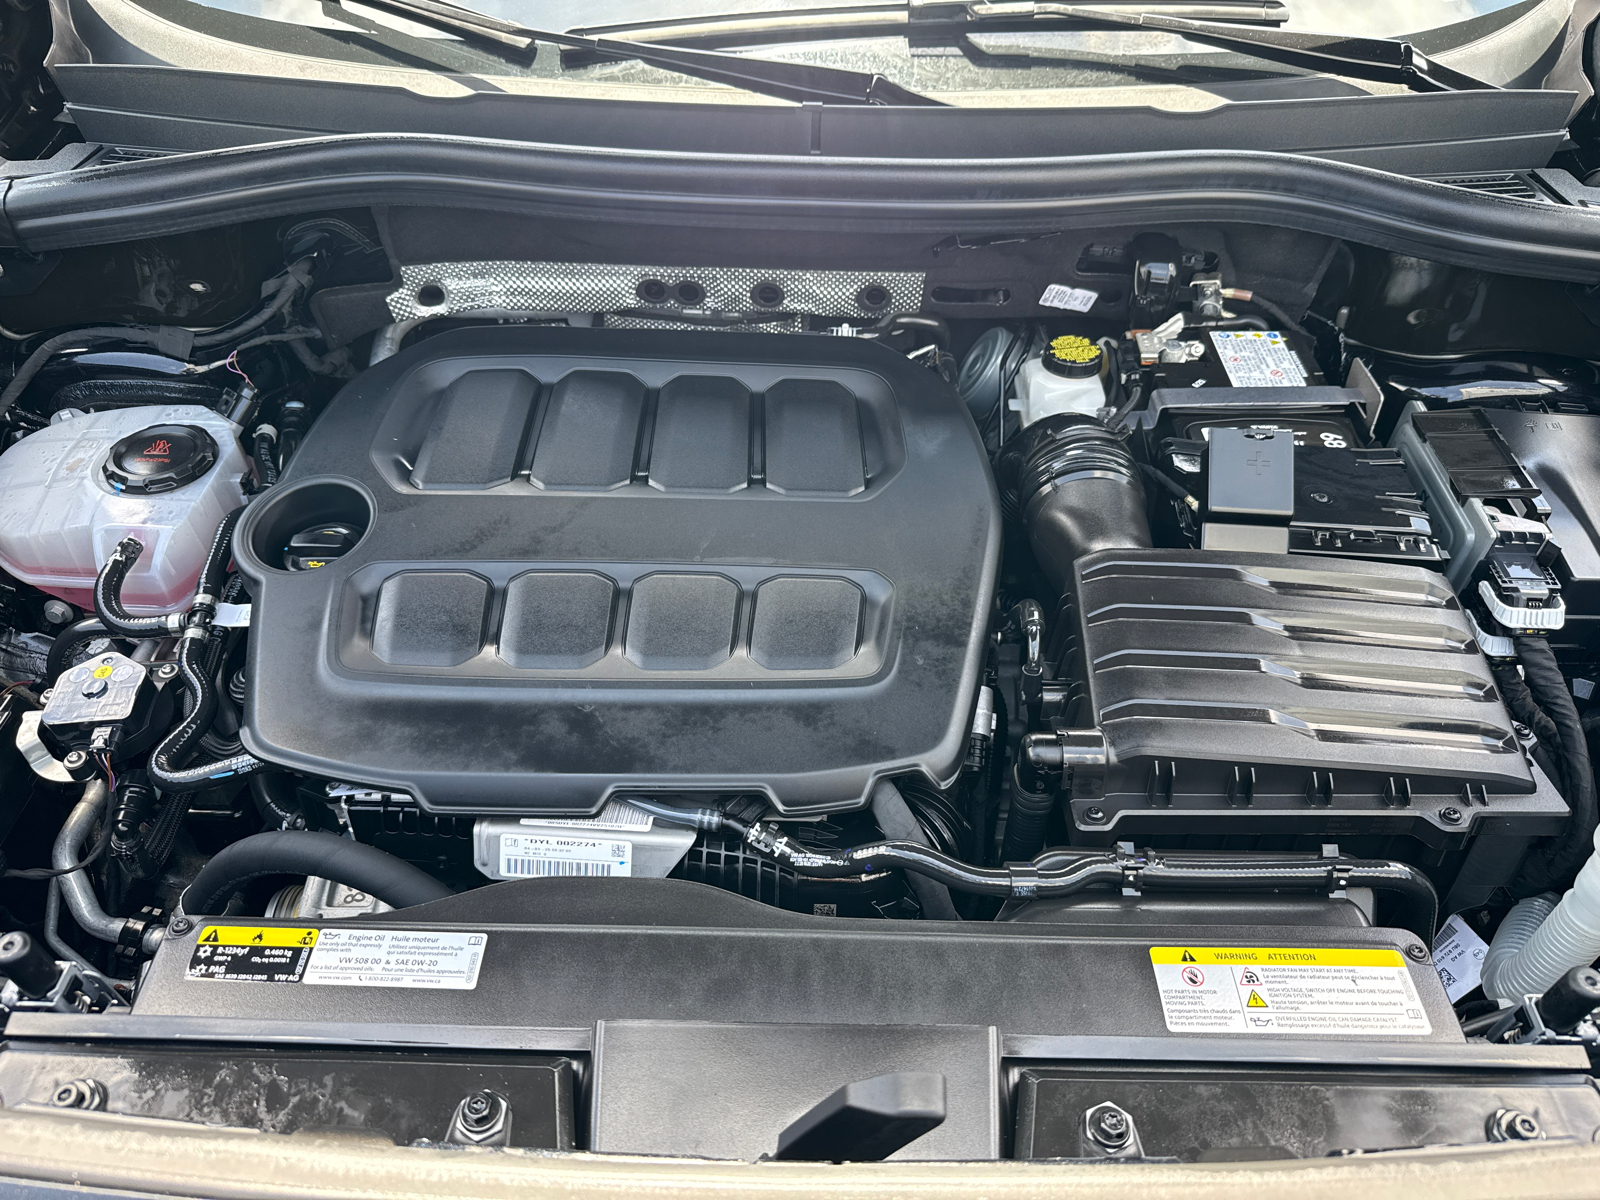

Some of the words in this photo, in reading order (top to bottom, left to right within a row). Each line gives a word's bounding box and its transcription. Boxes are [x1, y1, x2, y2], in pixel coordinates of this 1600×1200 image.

[348, 934, 373, 942] Engine
[216, 947, 250, 956] R-1234yf
[284, 949, 293, 957] kg
